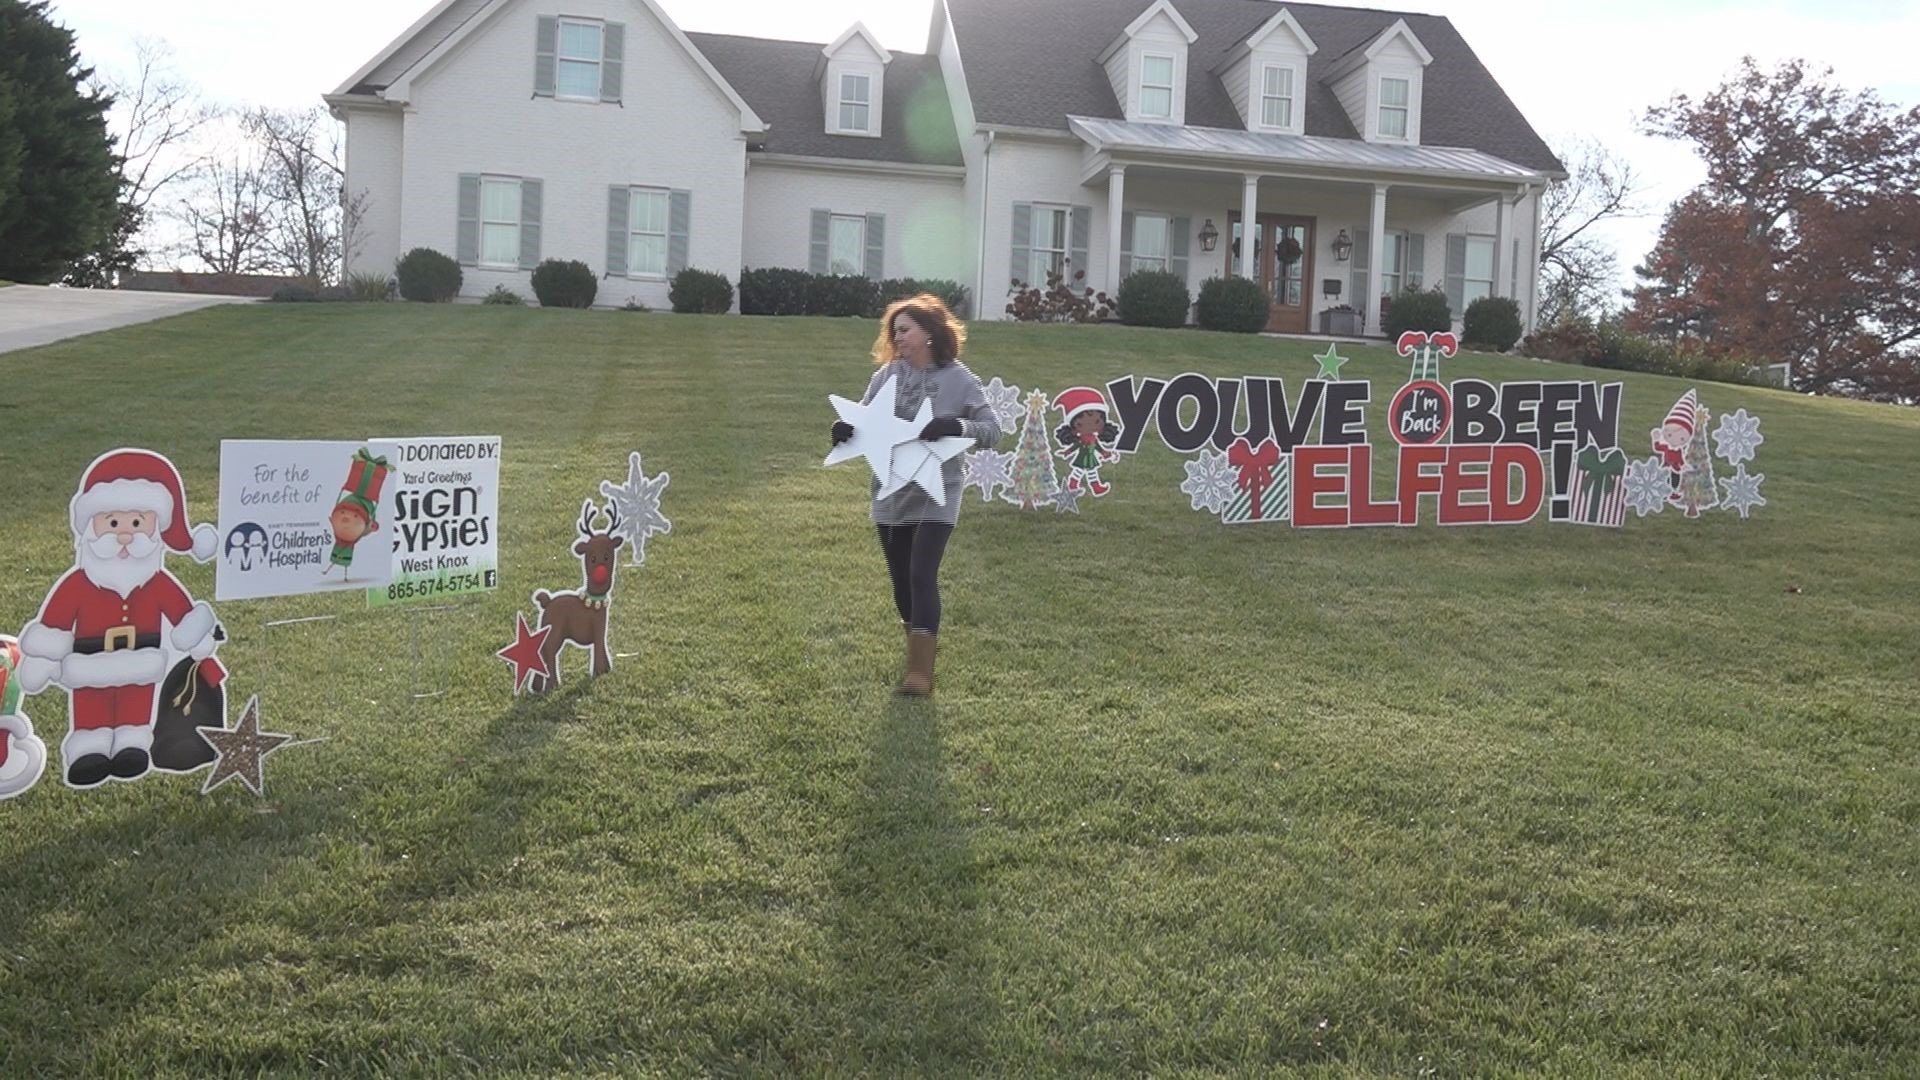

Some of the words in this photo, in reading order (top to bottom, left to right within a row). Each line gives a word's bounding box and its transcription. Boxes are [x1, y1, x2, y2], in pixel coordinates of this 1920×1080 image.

[1410, 388, 1438, 412] I'm
[1400, 410, 1441, 434] Back
[1451, 380, 1624, 453] BEEN
[254, 464, 276, 483] For
[285, 463, 310, 482] the
[403, 471, 426, 485] Yard
[427, 470, 472, 485] Greetings
[240, 484, 300, 505] benefit
[304, 484, 322, 504] of
[271, 529, 332, 549] Children's
[269, 547, 322, 570] Hospital
[401, 558, 433, 573] West
[437, 555, 469, 569] Knox
[388, 573, 480, 600] 865-674-5754
